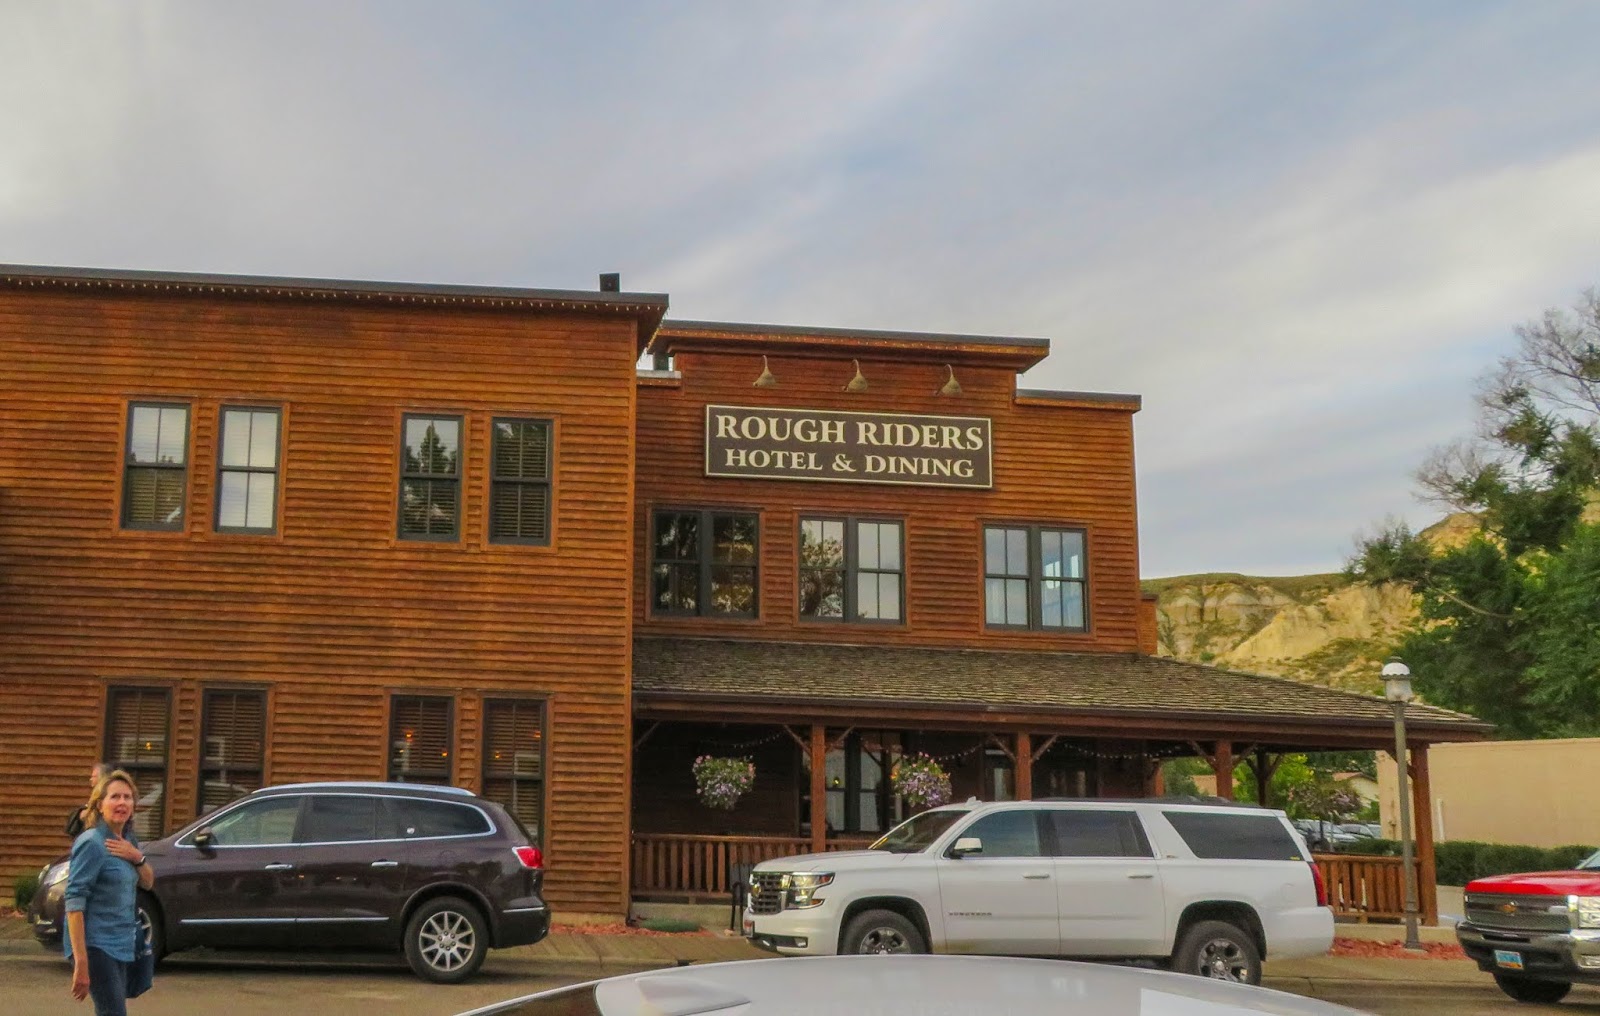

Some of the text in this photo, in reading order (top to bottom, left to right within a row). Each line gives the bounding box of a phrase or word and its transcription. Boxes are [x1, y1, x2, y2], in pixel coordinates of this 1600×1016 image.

[715, 414, 984, 450] ROUGH RIDERS
[725, 448, 974, 478] HOTEL & DINING
